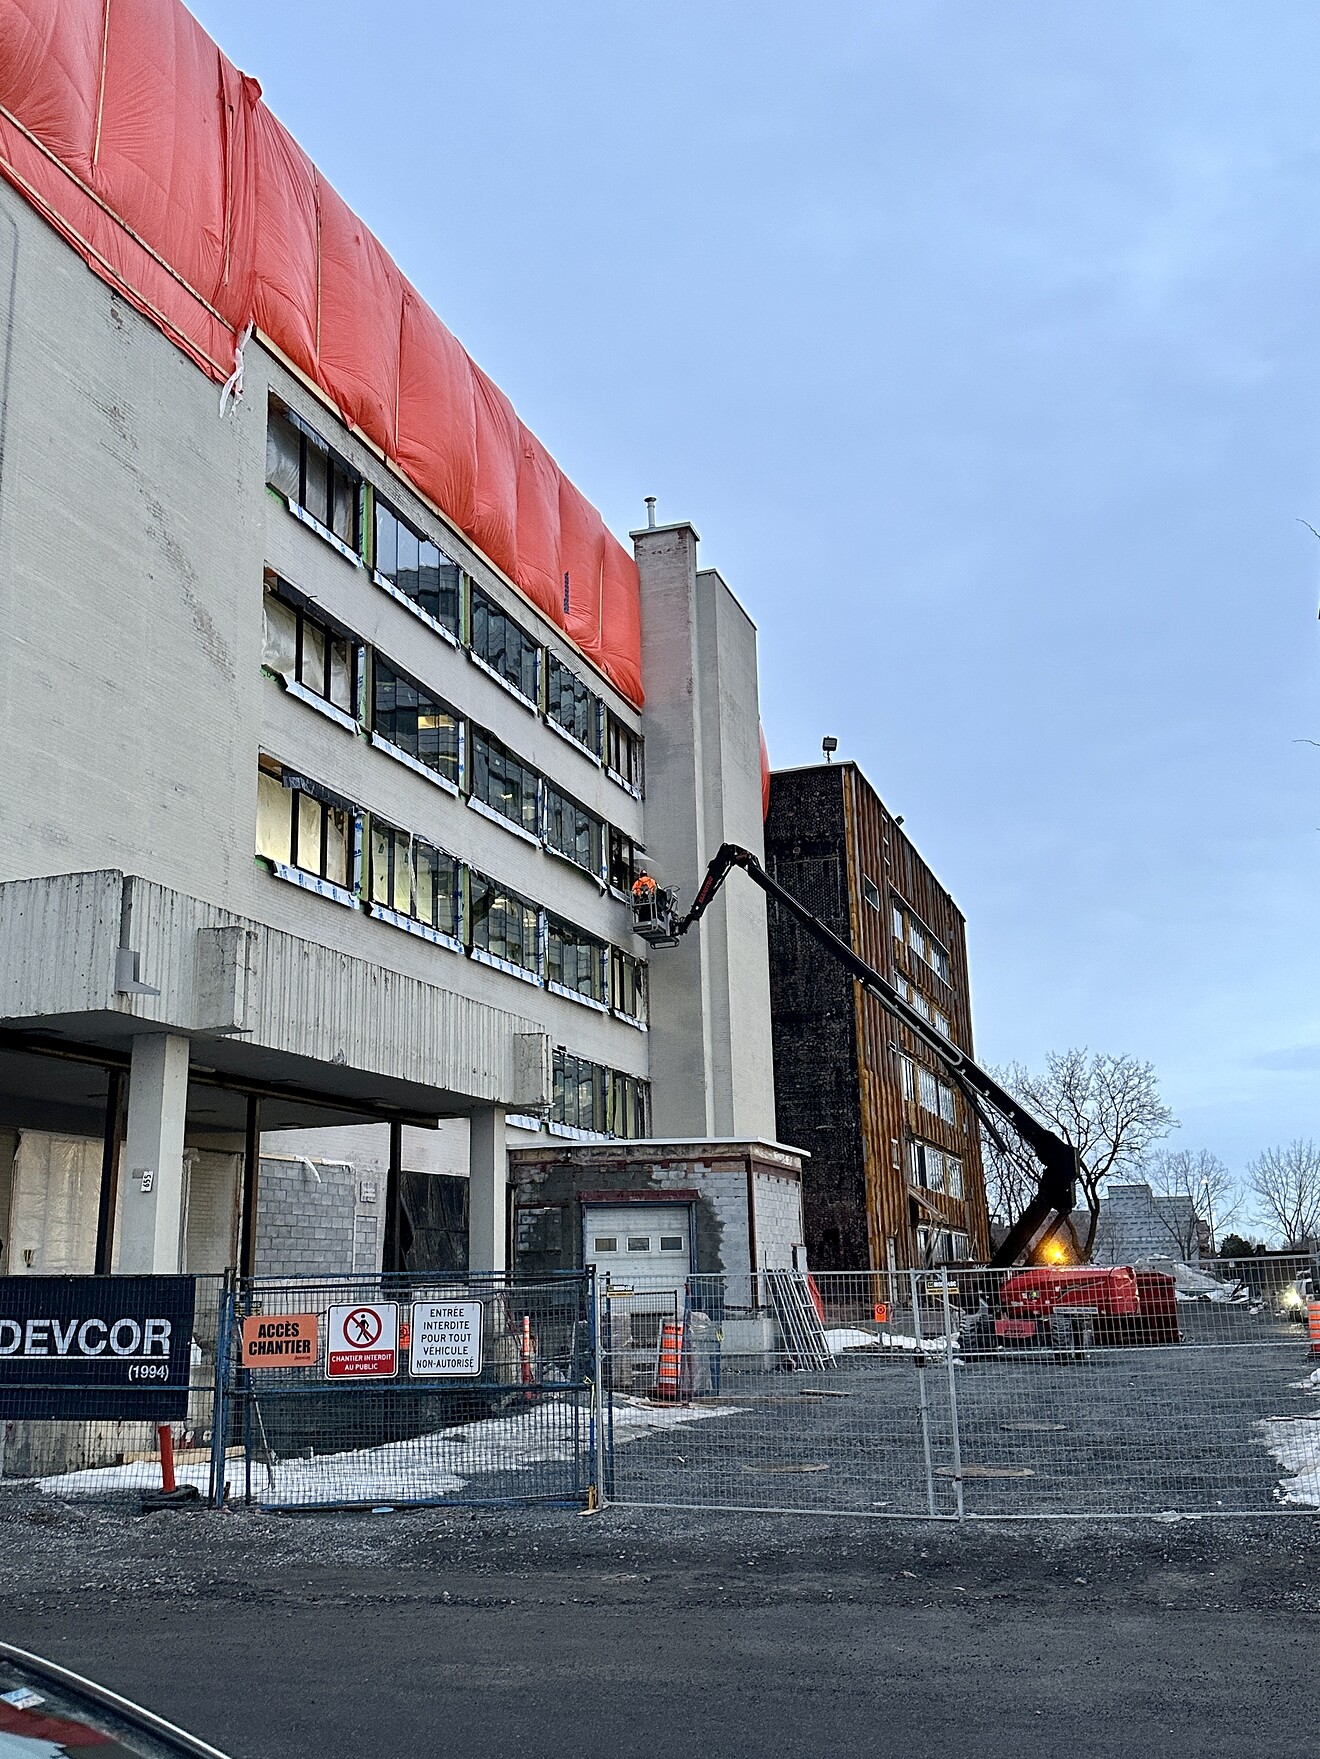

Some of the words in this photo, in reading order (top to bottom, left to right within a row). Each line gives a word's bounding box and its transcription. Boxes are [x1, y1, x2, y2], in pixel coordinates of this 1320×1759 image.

[142, 1174, 152, 1188] 655
[430, 1306, 465, 1318] ENTRÉE
[258, 1321, 300, 1339] ACCÈS
[423, 1321, 470, 1331] INTERDITE
[0, 1318, 172, 1355] DEVCOR
[421, 1333, 446, 1343] POUR
[448, 1333, 472, 1342] TOUT
[248, 1339, 311, 1356] CHANTIER
[423, 1344, 469, 1356] VÉHICULE
[364, 1353, 392, 1361] INTERDIT
[416, 1356, 474, 1369] NON-AUTORISÉ
[128, 1364, 170, 1381] (1994)
[355, 1363, 378, 1371] PUBLIC
